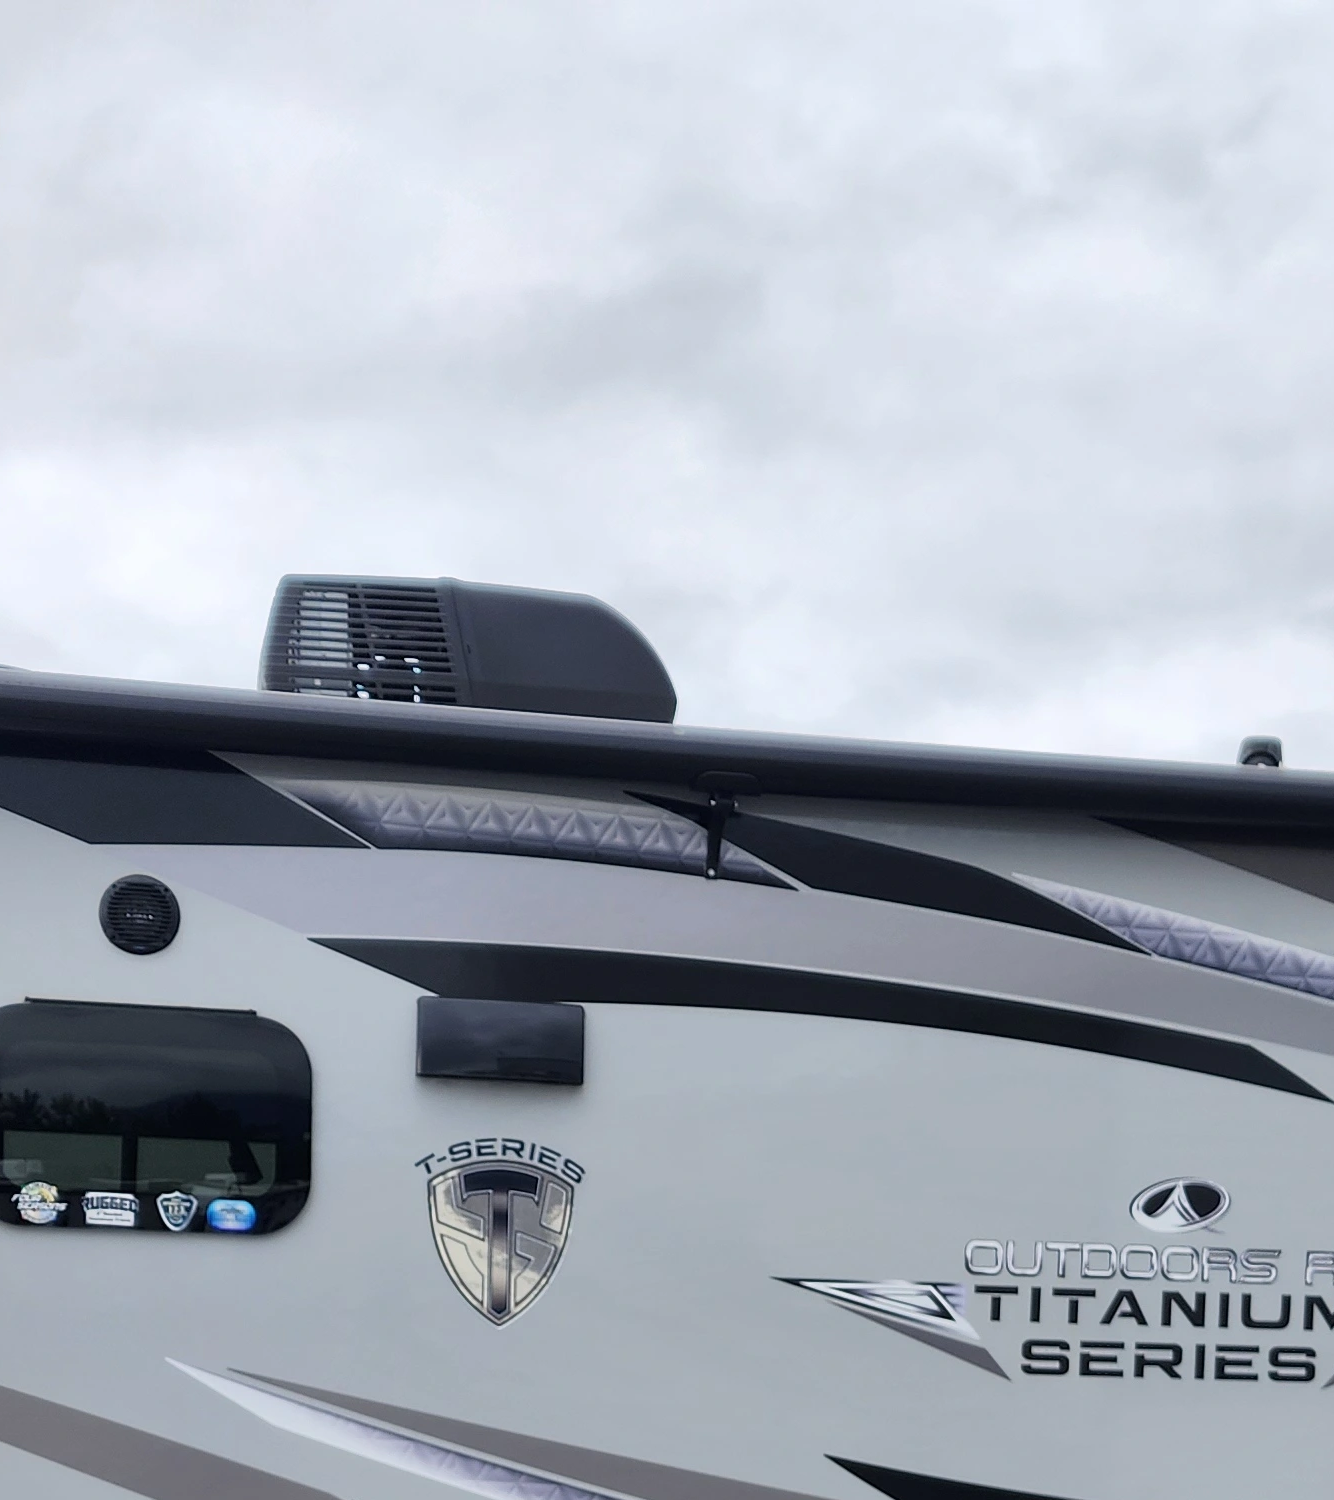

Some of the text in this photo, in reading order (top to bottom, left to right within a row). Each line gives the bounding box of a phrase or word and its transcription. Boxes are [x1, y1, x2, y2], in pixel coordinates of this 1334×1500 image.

[414, 1137, 586, 1185] T-SERIES
[81, 1195, 139, 1212] RUGGED
[964, 1237, 1281, 1285] OUTDOORS
[1020, 1339, 1317, 1382] SERIES
